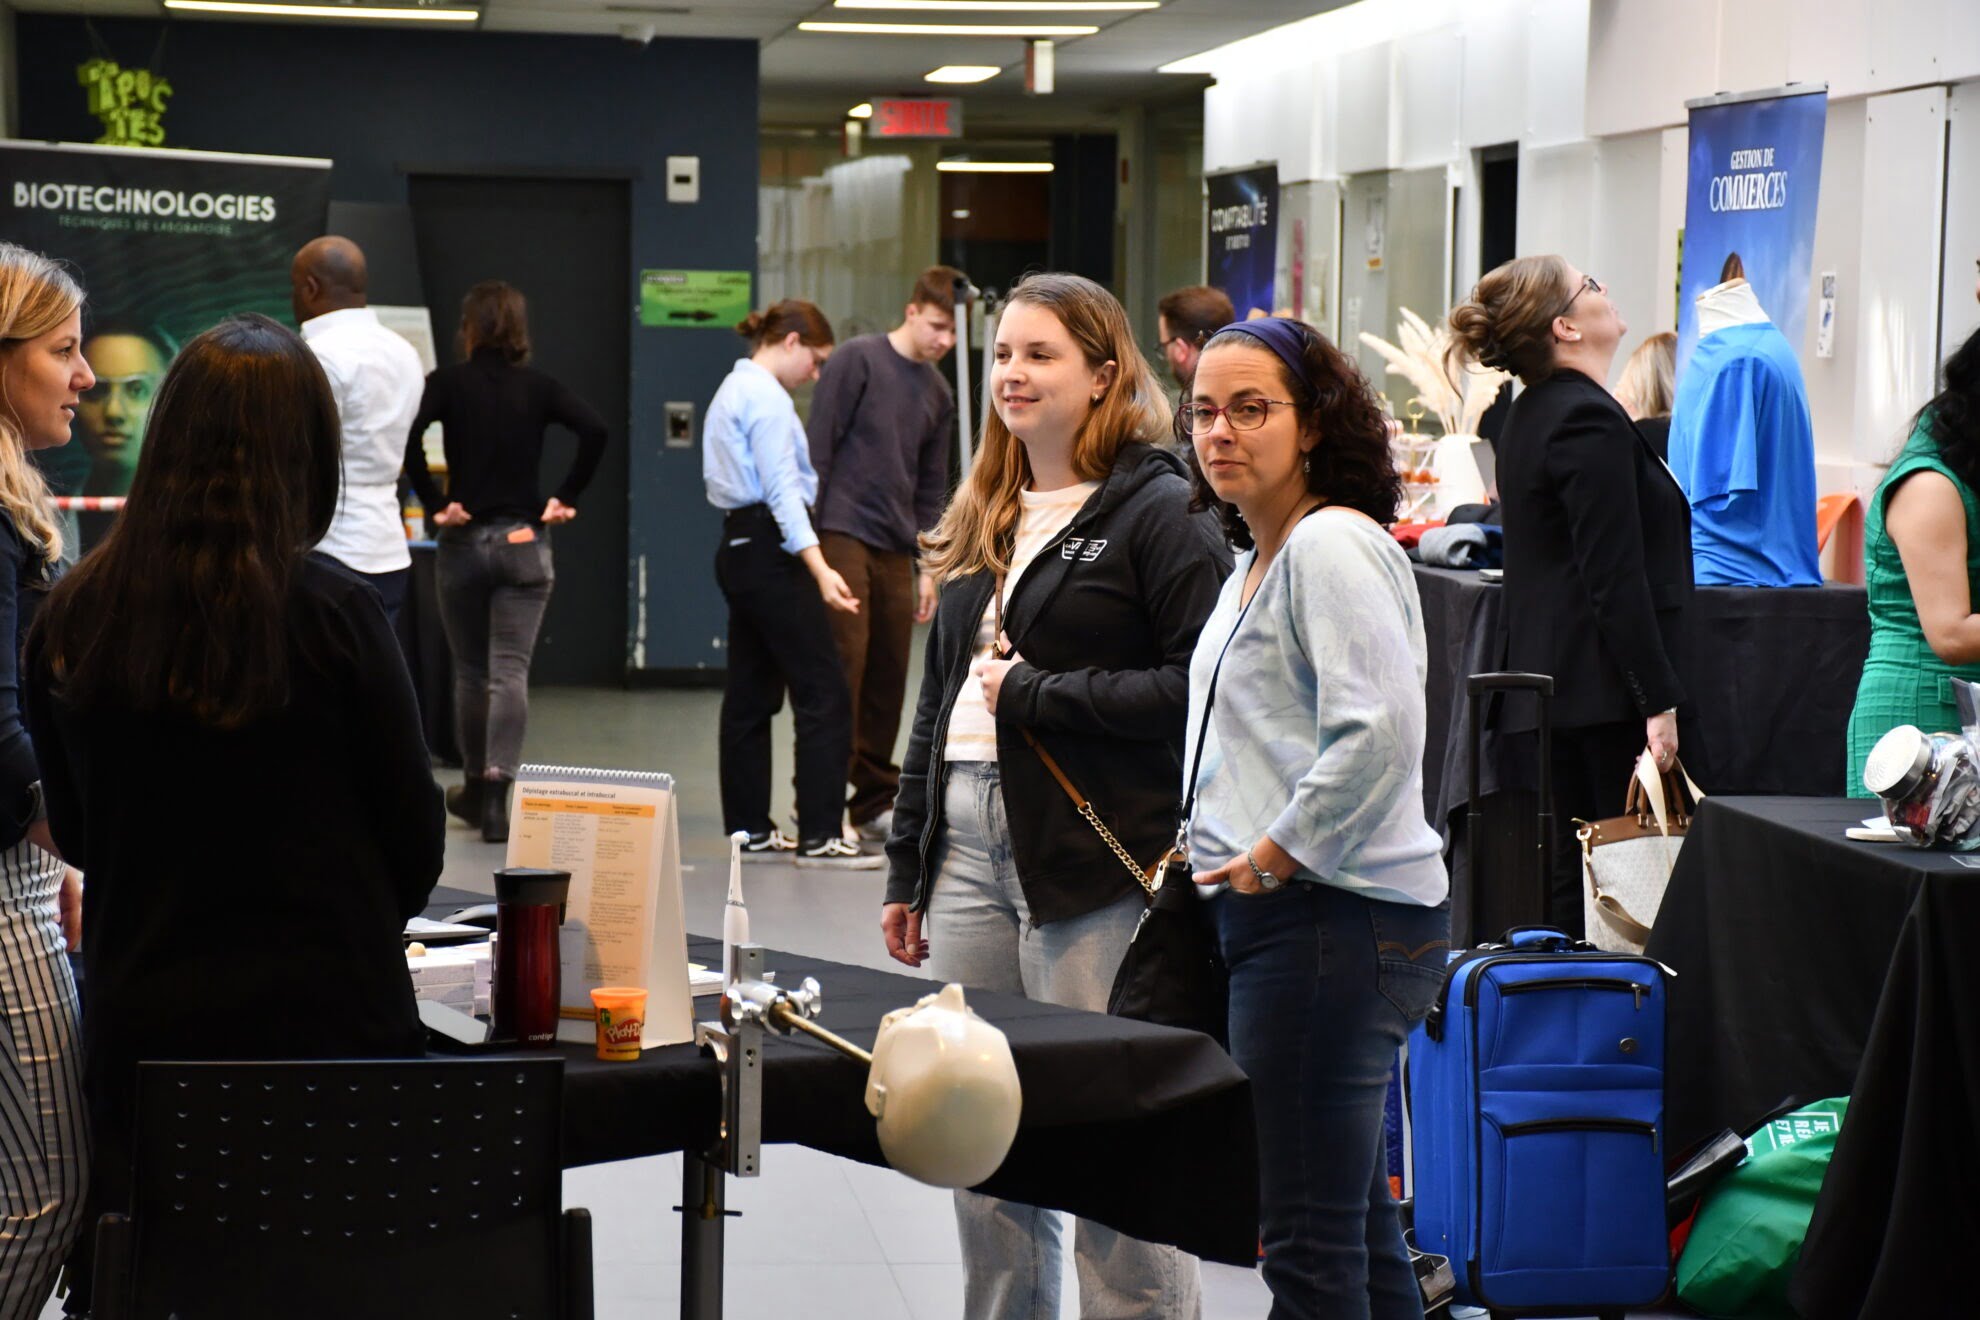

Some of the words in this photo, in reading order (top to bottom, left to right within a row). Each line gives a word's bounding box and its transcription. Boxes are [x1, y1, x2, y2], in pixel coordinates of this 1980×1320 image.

[1731, 149, 1763, 170] GESTION
[1763, 148, 1775, 167] DE
[13, 182, 276, 222] BIOTECHNOLOGIES
[1710, 171, 1787, 212] COMMERCES
[58, 214, 130, 231] TECHNIQUES
[134, 220, 149, 232] DE
[153, 221, 233, 236] LABORATOIRE
[522, 787, 549, 796] Dépistage
[1775, 1119, 1791, 1133] ET
[1815, 1119, 1831, 1133] JE
